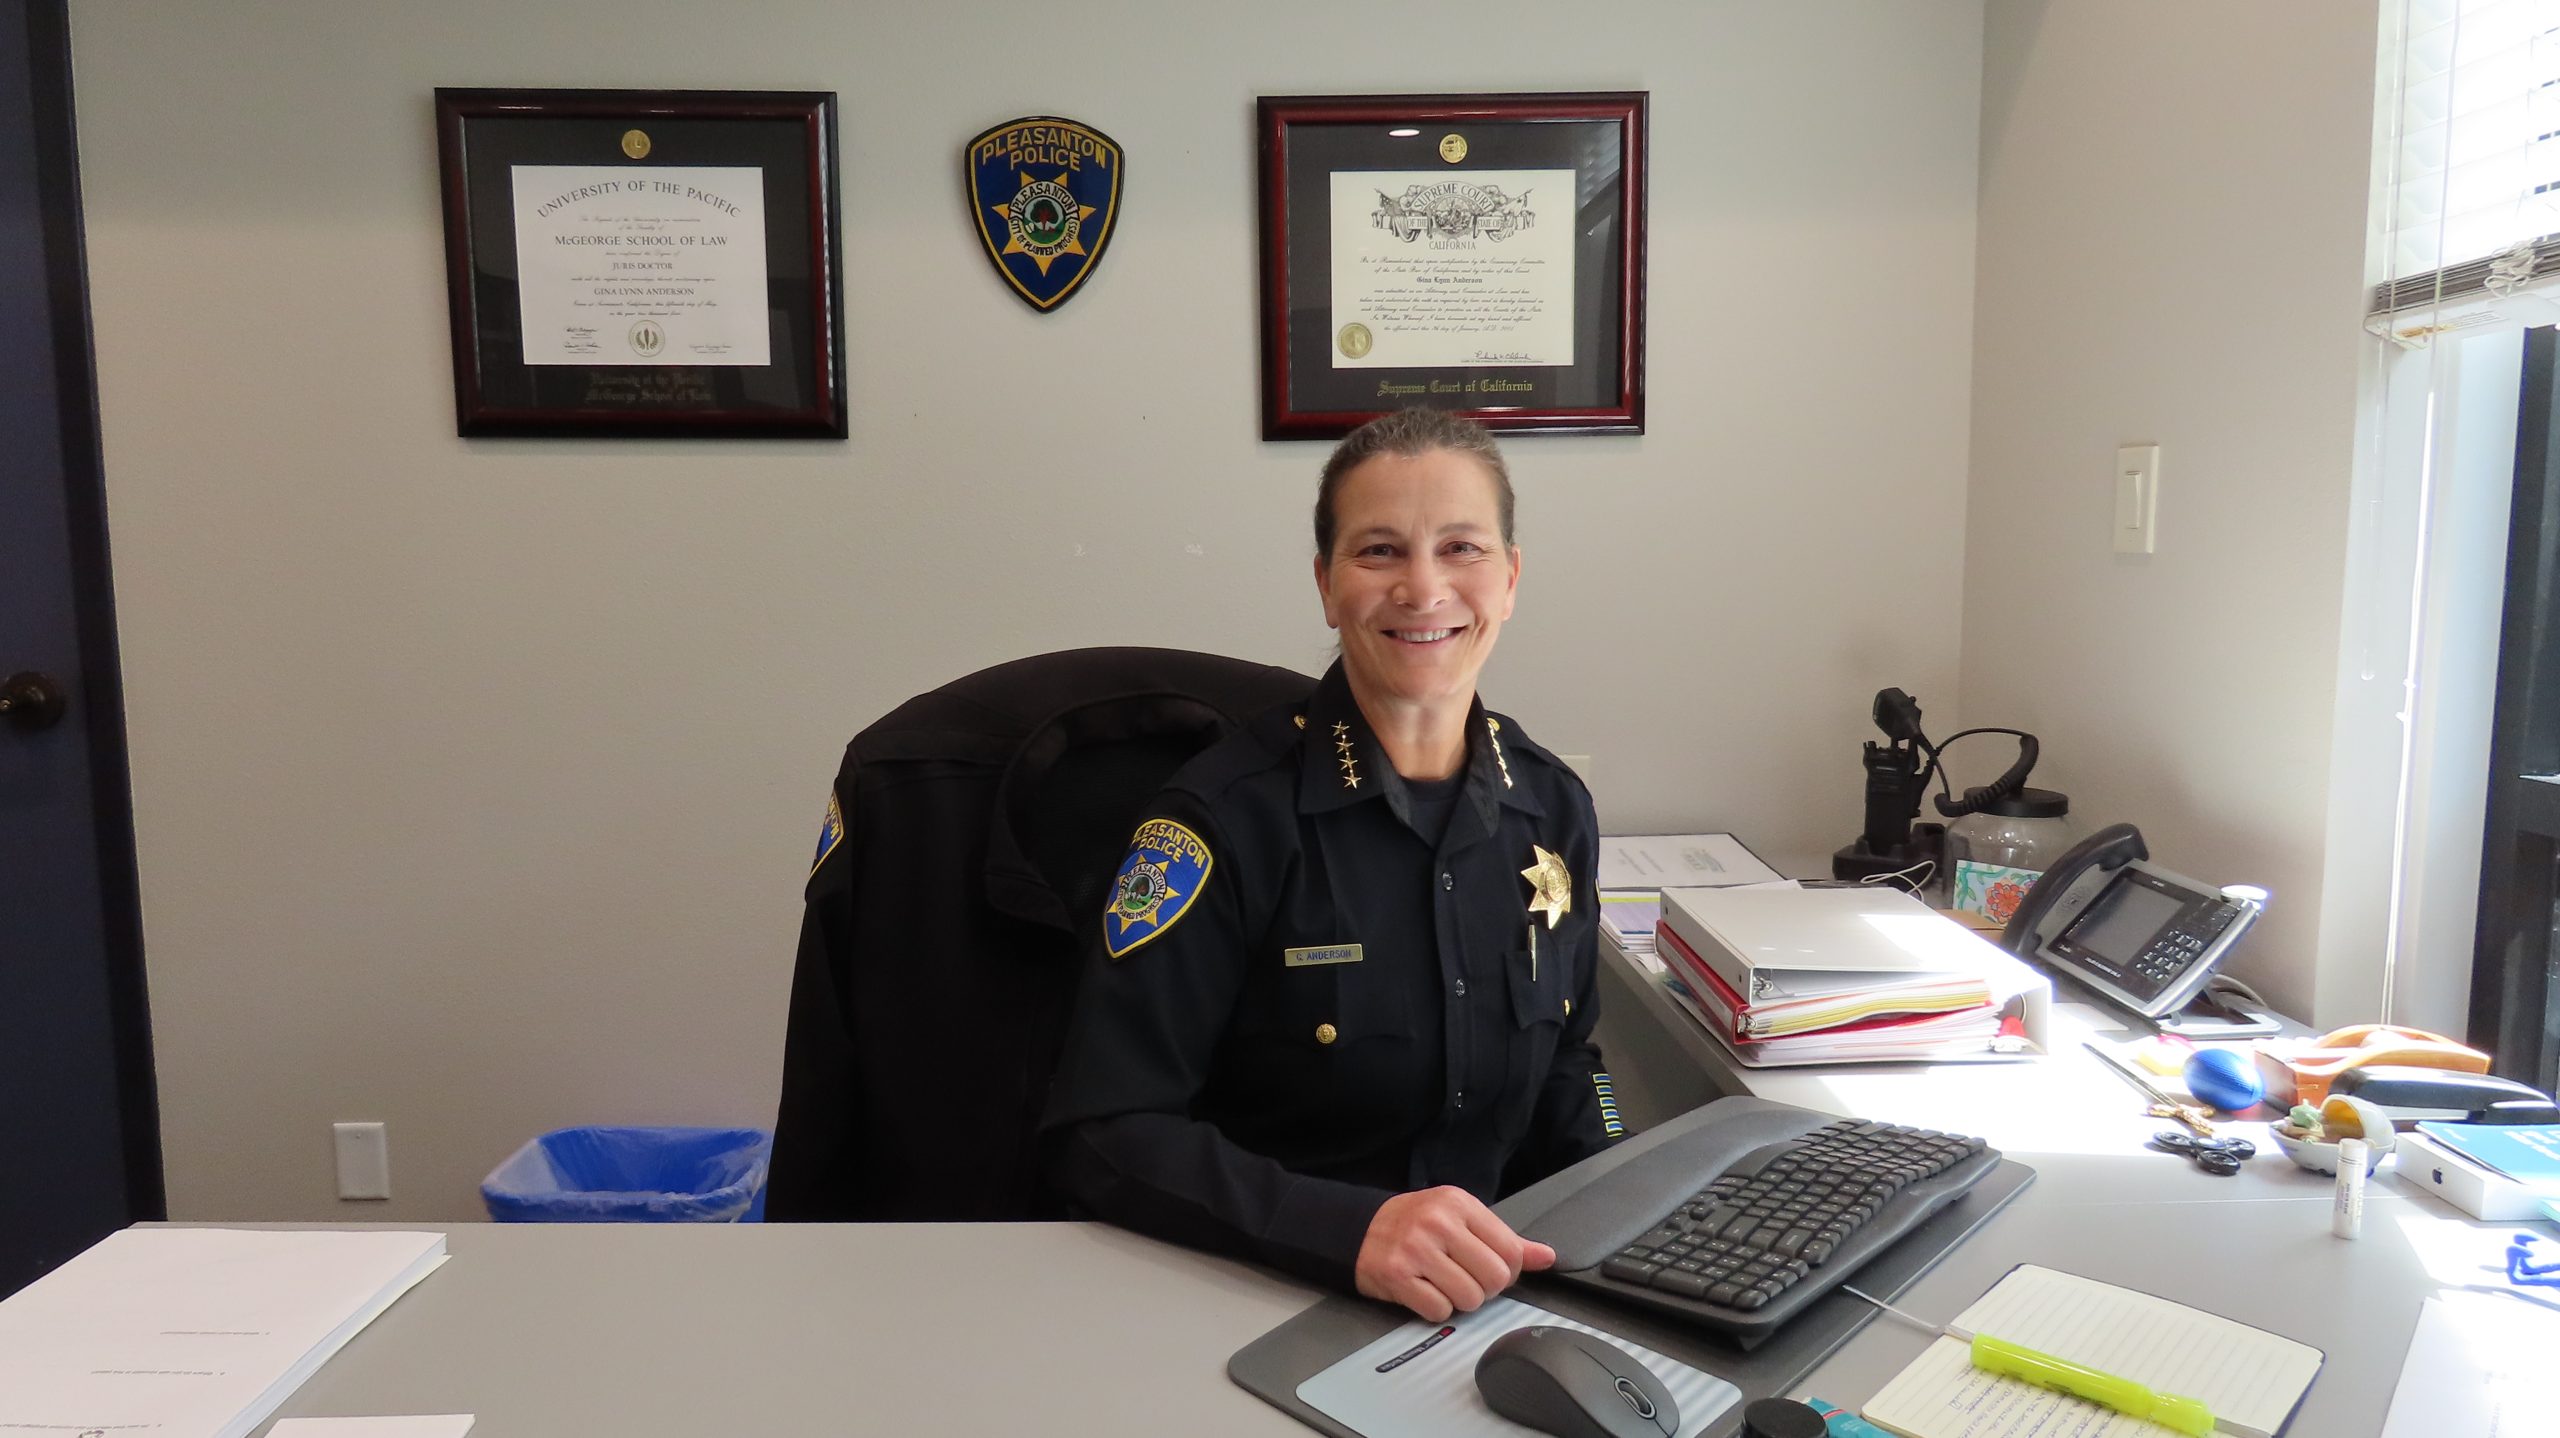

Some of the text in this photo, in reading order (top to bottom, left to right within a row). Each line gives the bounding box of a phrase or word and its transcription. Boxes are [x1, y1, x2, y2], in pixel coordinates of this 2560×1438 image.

[982, 127, 1107, 169] PLEASANTON
[1010, 147, 1081, 172] POLICE
[537, 180, 741, 218] UNIVERSITY OF THE PACIFIC
[1012, 183, 1076, 211] PLEASANTON
[1414, 183, 1493, 211] SUPREME COURT
[555, 235, 728, 246] McGEORGE SCHOOL OF LAW
[1429, 241, 1476, 250] CALIFORNIA
[637, 262, 673, 270] DOCTOR
[594, 288, 695, 296] GINA LYNN ANDERSON
[1430, 379, 1462, 393] Court
[1465, 380, 1477, 392] of
[1480, 378, 1534, 393] California
[1130, 824, 1206, 869] LEASANTON
[1137, 836, 1184, 863] POLICE
[1306, 949, 1352, 961] ANDERSON
